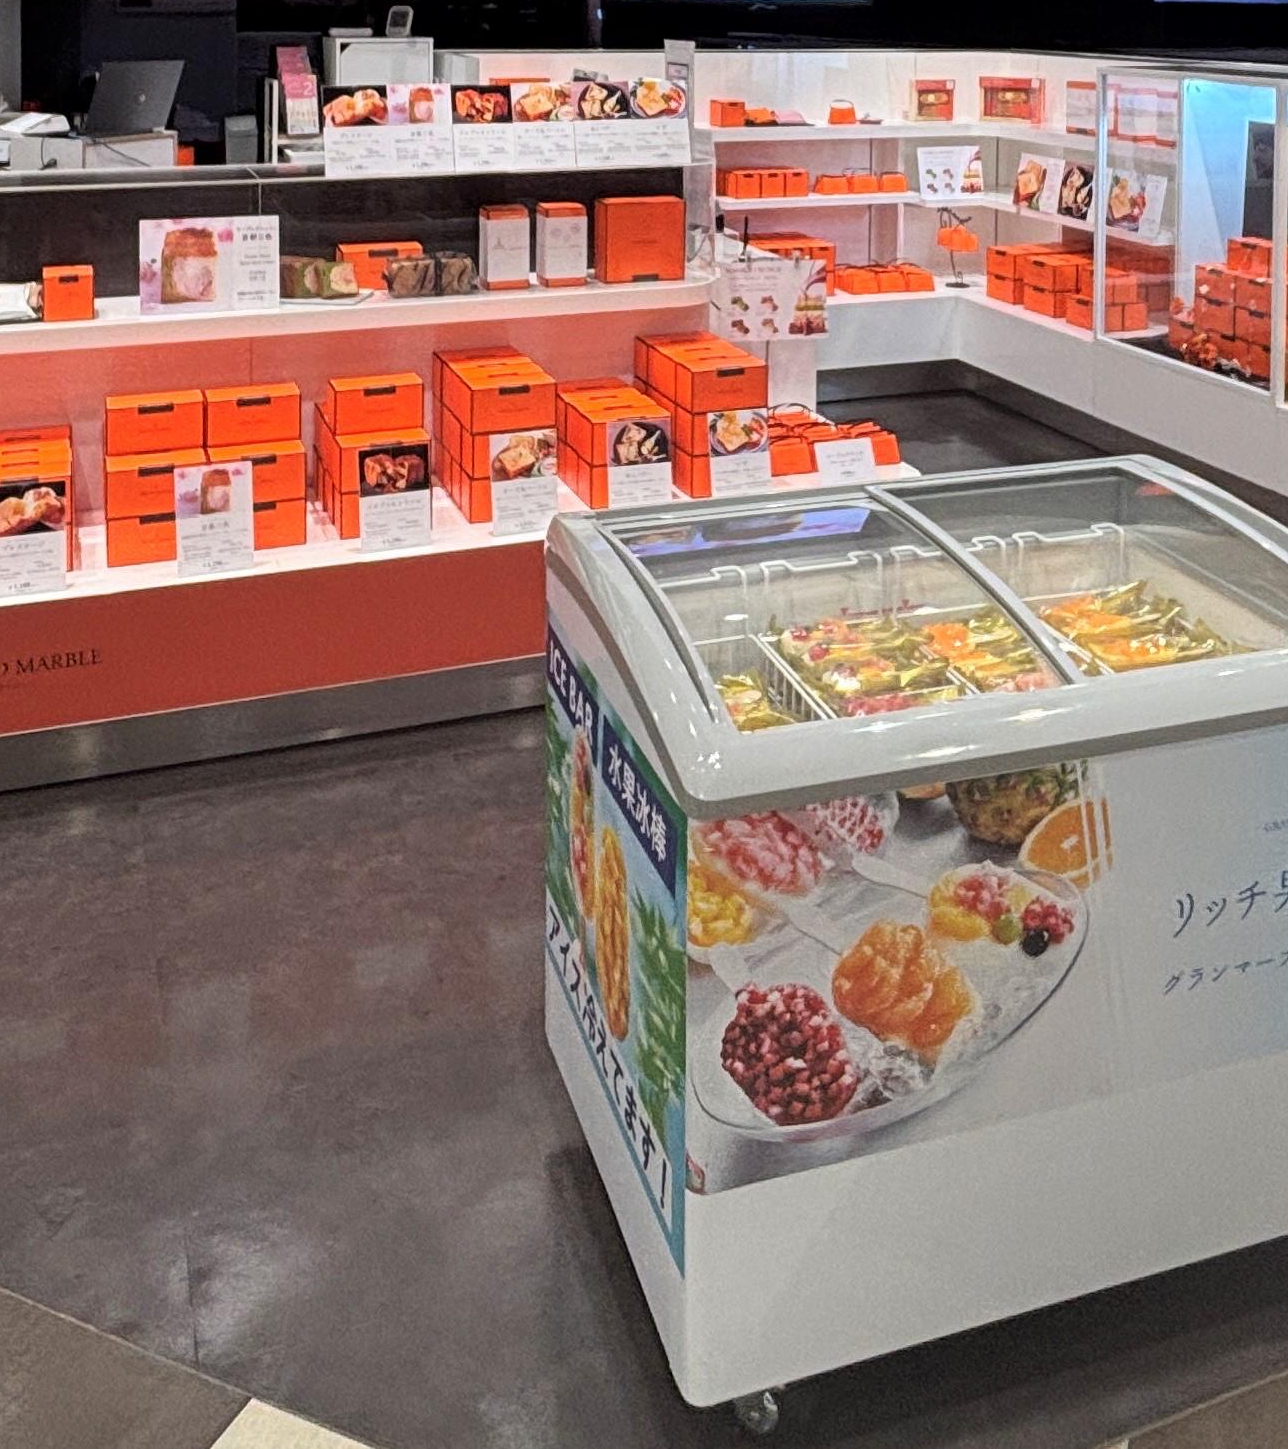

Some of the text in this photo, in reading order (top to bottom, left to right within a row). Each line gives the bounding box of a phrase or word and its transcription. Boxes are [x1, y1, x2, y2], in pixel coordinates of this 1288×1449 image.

[16, 648, 103, 676] MARBLE
[548, 641, 594, 746] ICE BAR
[607, 743, 668, 863] 水果冰棒
